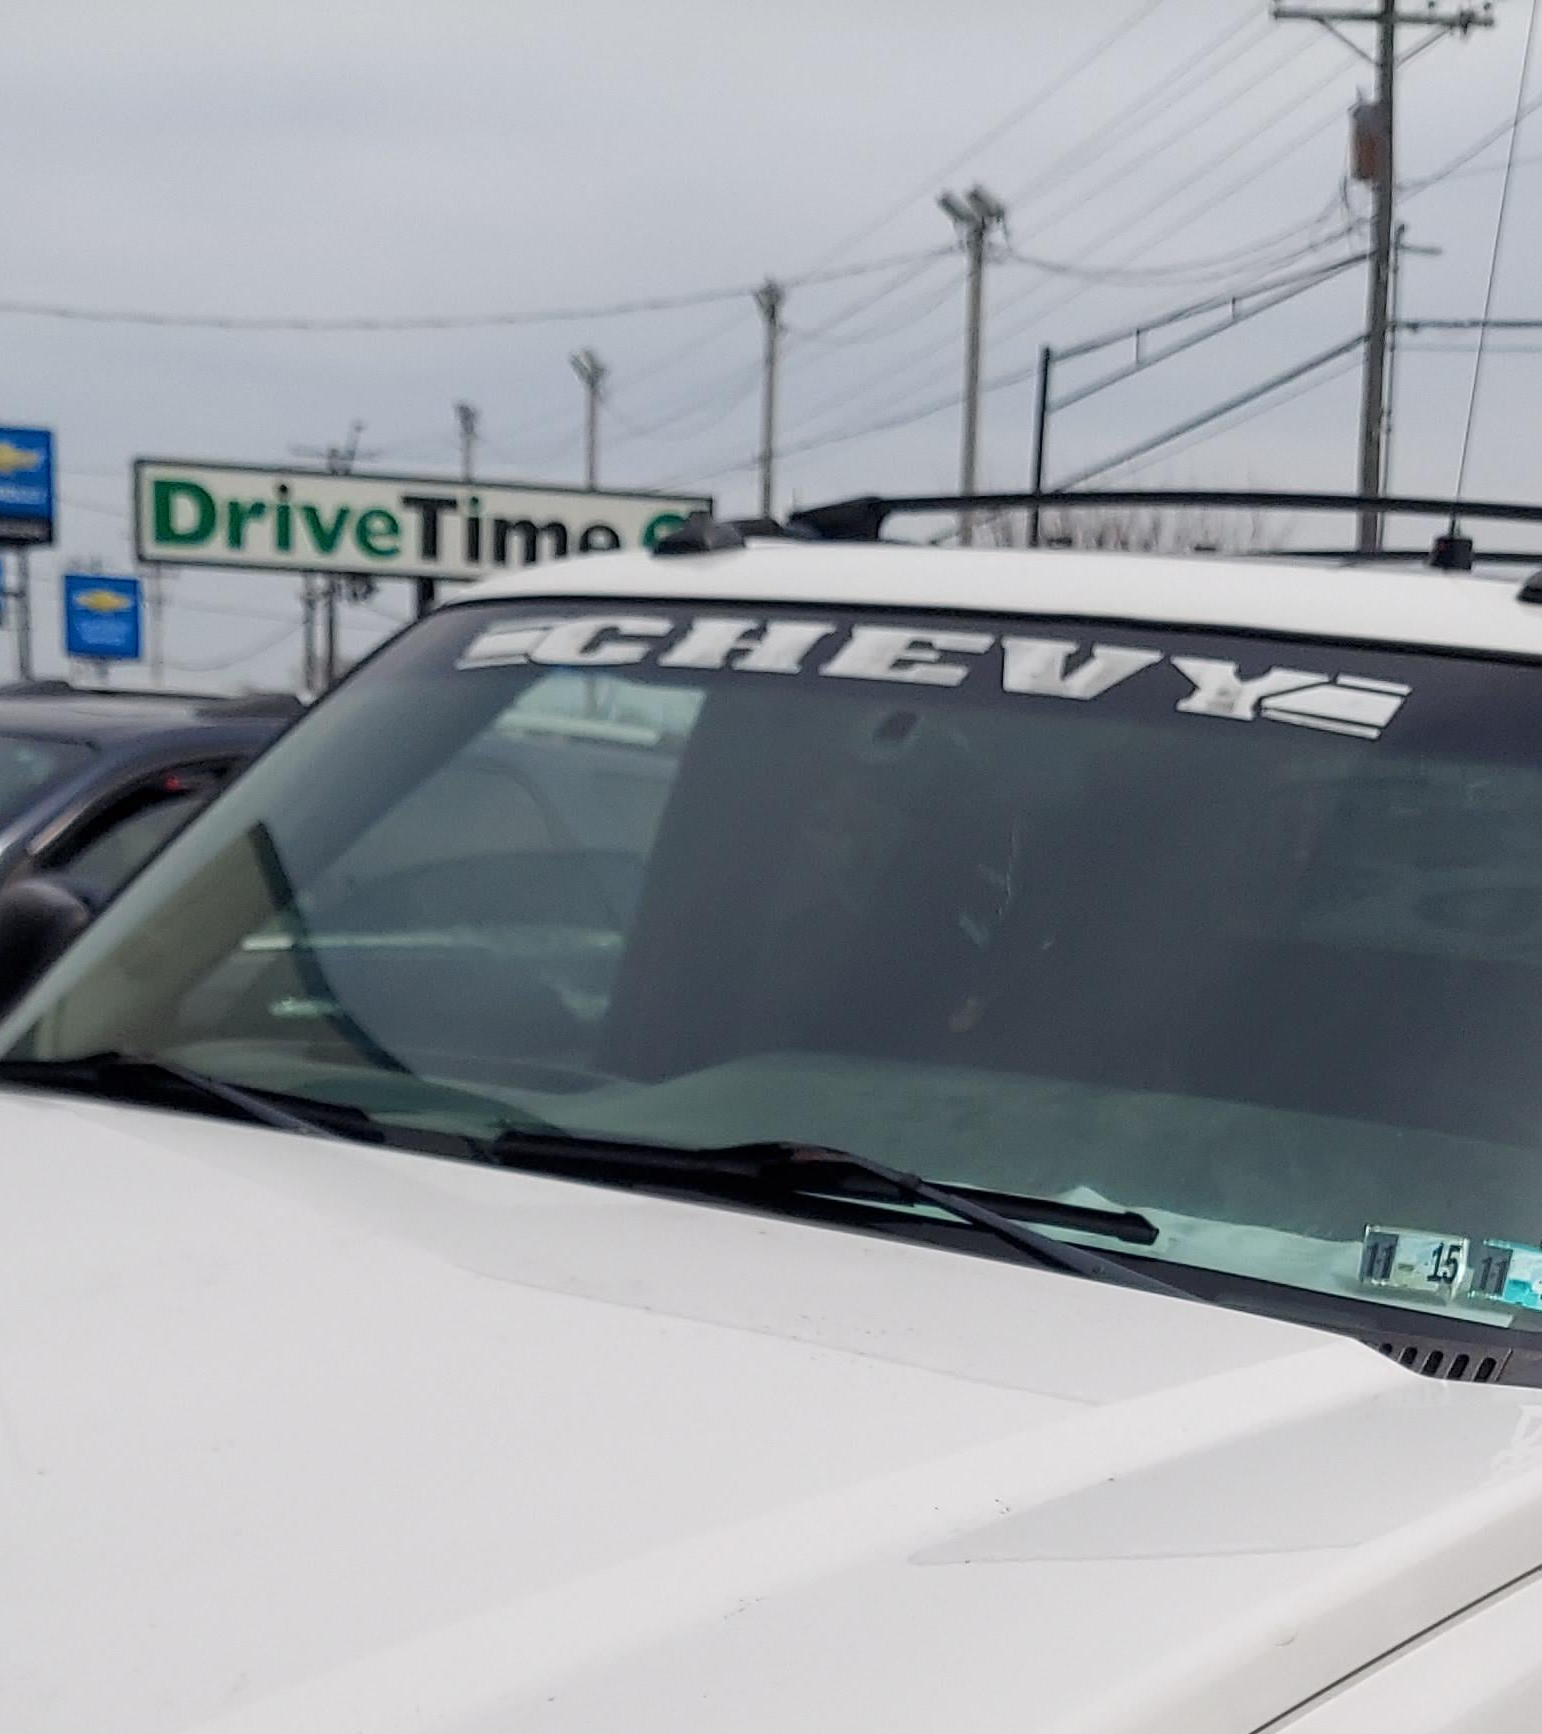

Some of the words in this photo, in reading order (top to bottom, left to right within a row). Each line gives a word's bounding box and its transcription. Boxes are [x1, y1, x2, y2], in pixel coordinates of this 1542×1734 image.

[153, 479, 621, 568] DriveTime
[525, 614, 1329, 722] CHEVY
[1366, 1242, 1396, 1283] 11
[1427, 1241, 1462, 1284] 15
[1479, 1256, 1508, 1295] 11
